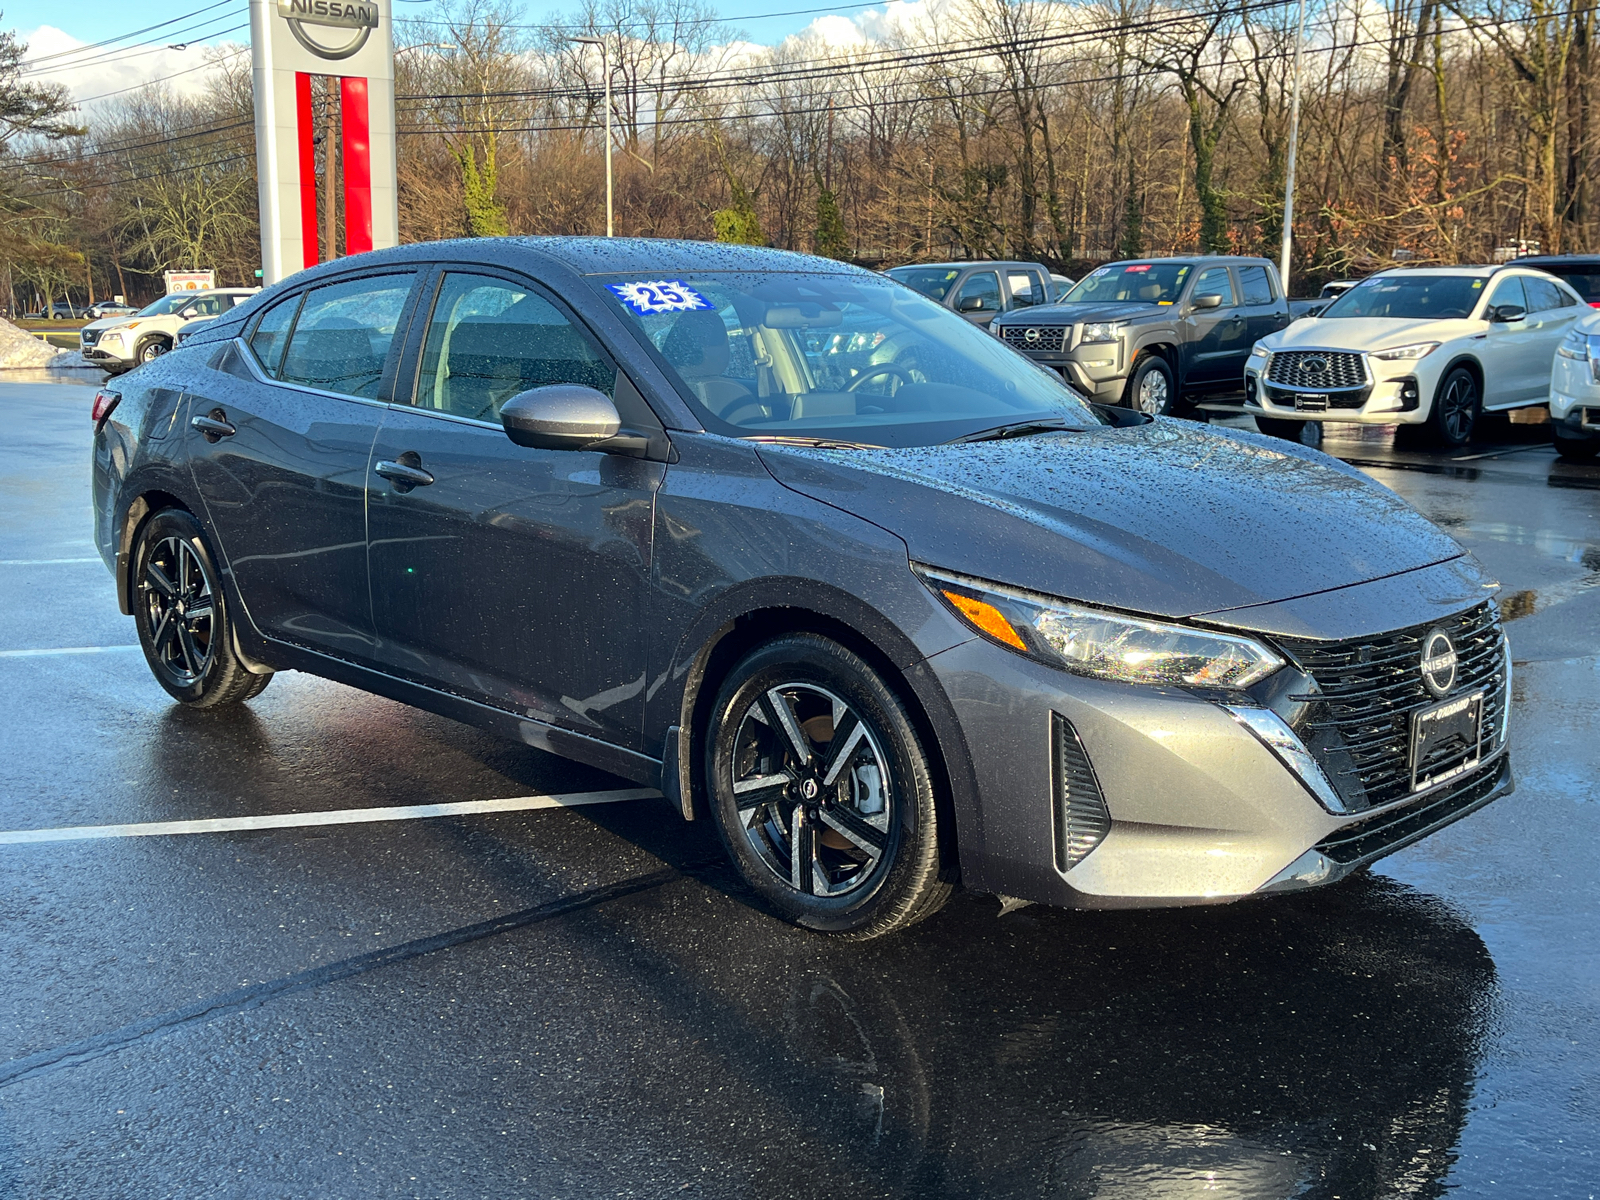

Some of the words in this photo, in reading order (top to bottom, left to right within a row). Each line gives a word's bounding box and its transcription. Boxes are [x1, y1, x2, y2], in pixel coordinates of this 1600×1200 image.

[290, 0, 371, 21] NISSAN
[636, 285, 685, 306] 25
[1423, 652, 1457, 673] NISSAN
